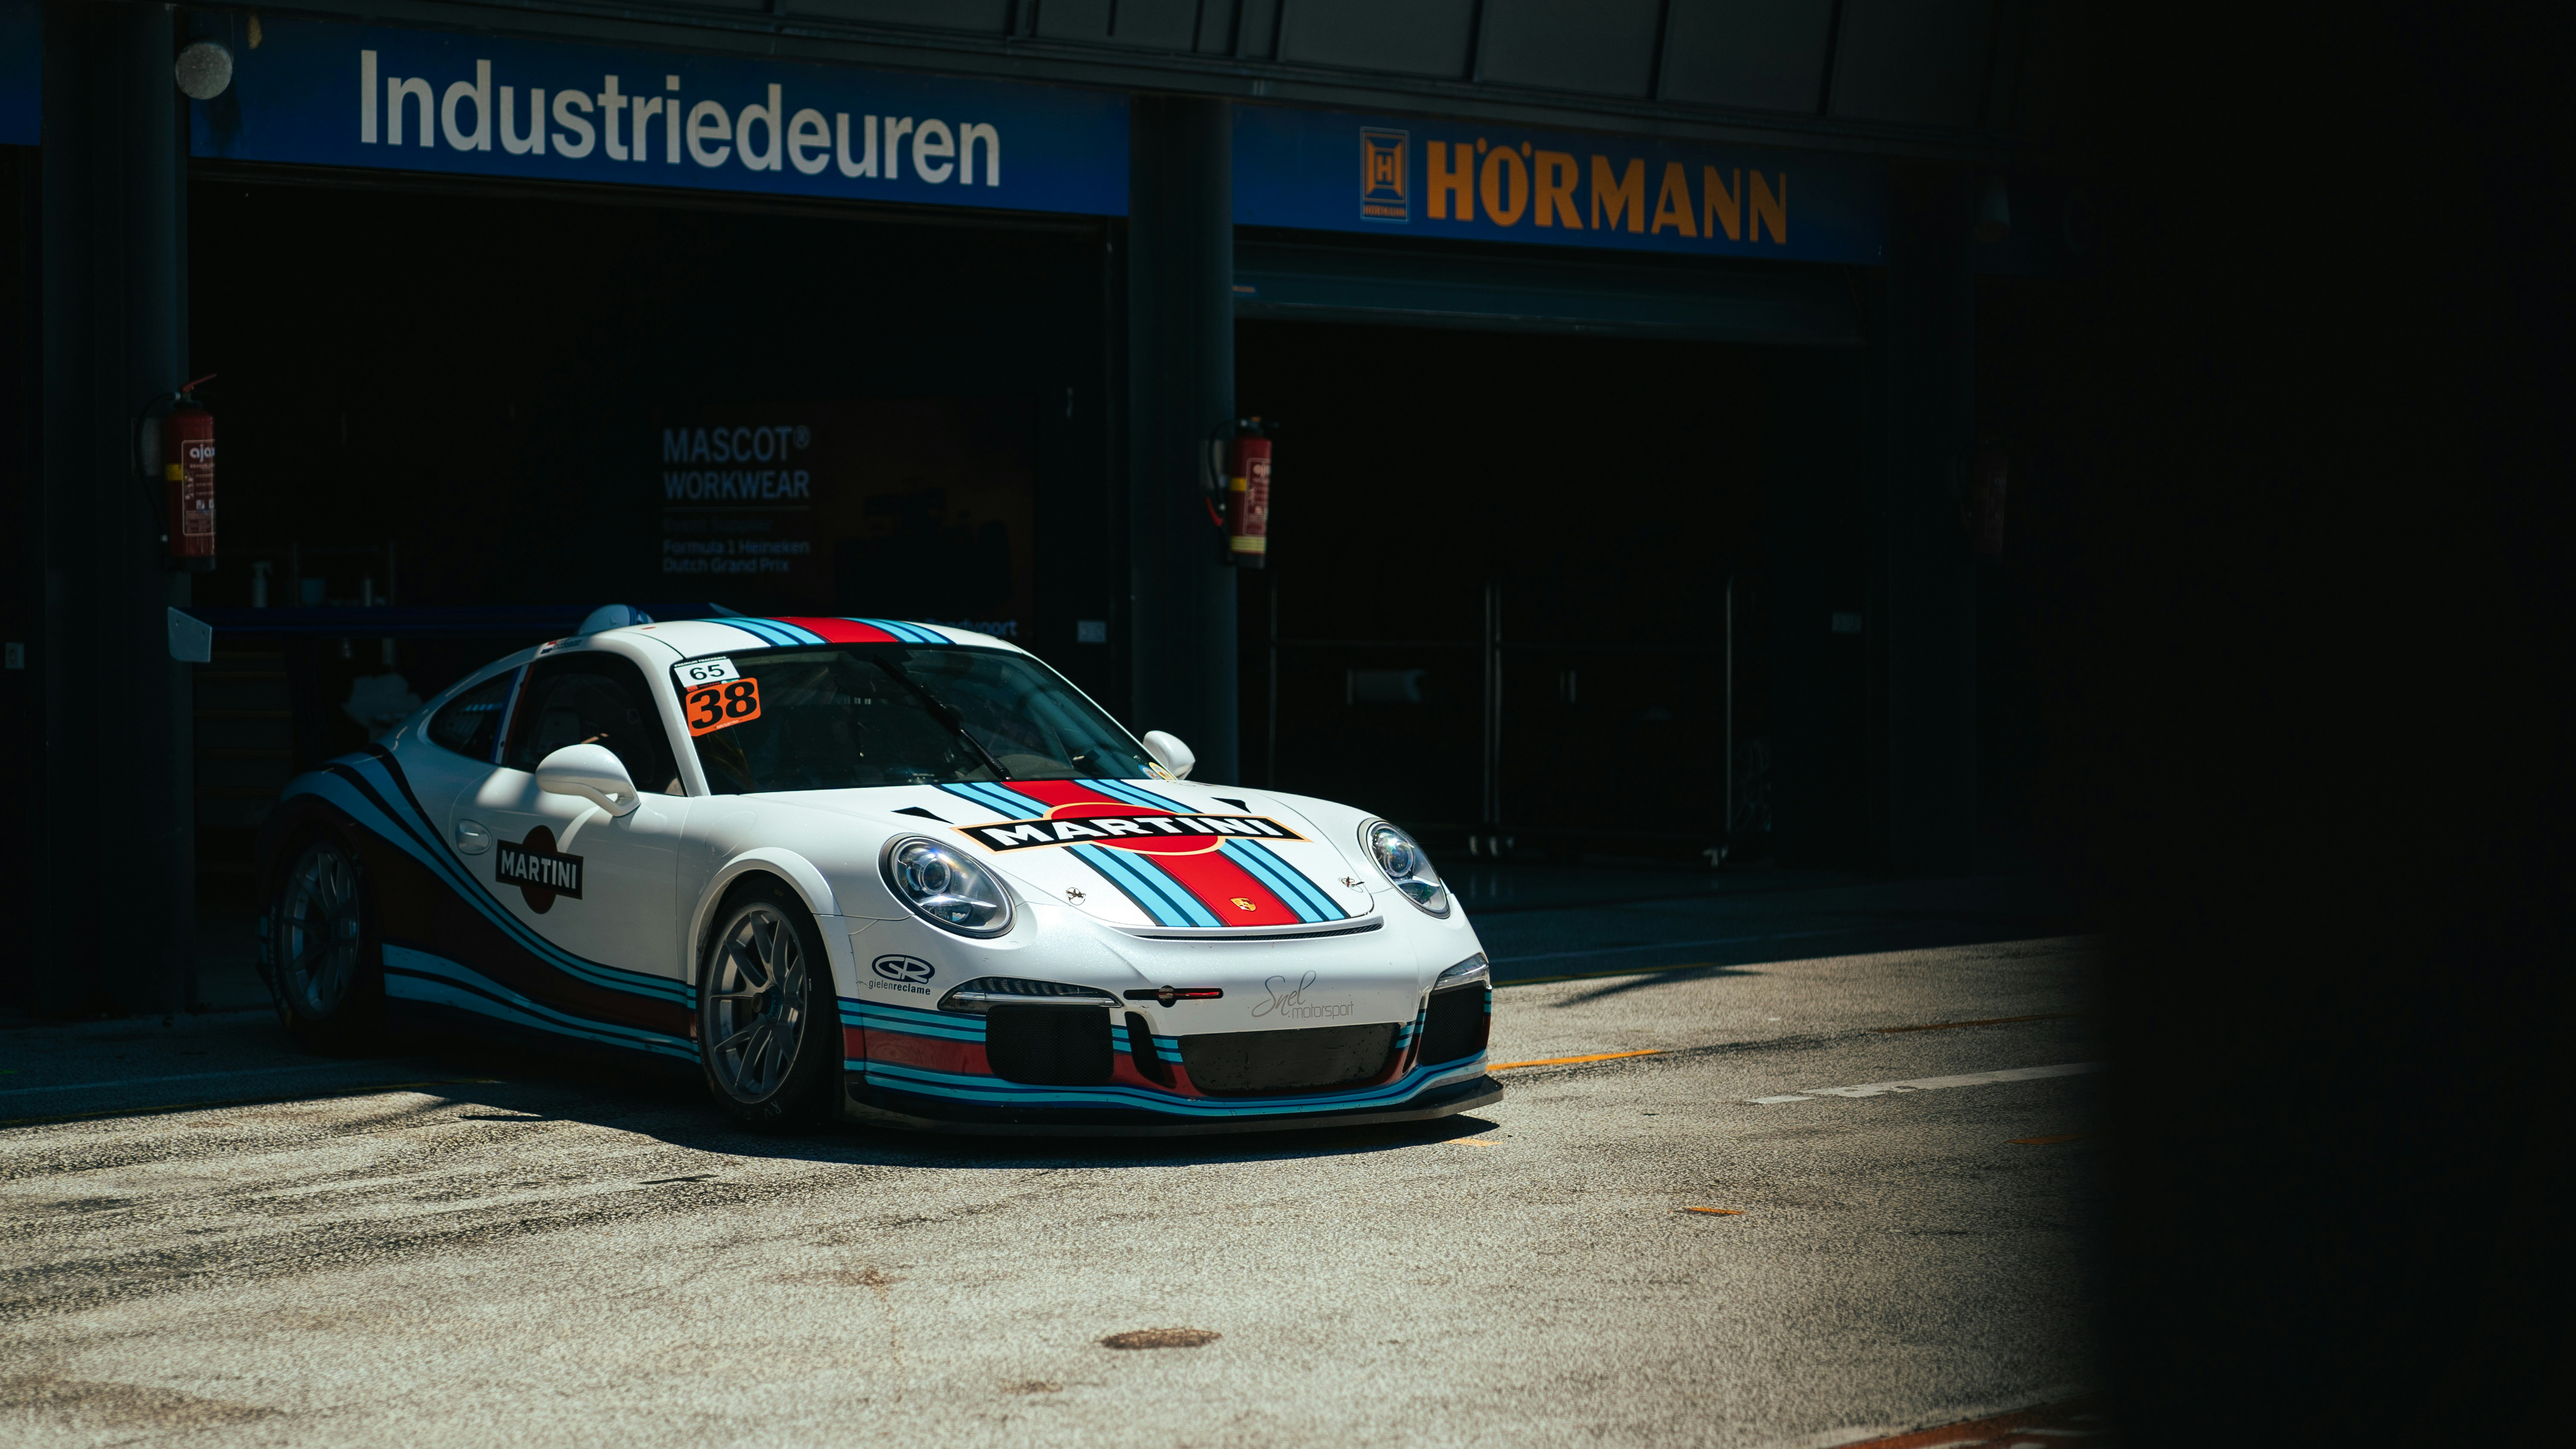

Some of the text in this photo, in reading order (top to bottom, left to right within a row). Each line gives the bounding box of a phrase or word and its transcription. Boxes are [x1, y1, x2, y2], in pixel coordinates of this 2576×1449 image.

[361, 49, 1000, 187] Industriedeuren
[1427, 137, 1787, 245] HÖRMANN
[662, 469, 811, 502] WORKWEAR
[662, 539, 811, 555] Formula 1 Heineken
[662, 557, 791, 574] Dutch Grand Prix
[689, 664, 725, 680] 65
[690, 681, 757, 729] 38
[981, 817, 1283, 846] MARTINI
[501, 849, 576, 889] MARTINI
[1251, 970, 1317, 1018] Snel
[1291, 1001, 1354, 1020] motorsport
